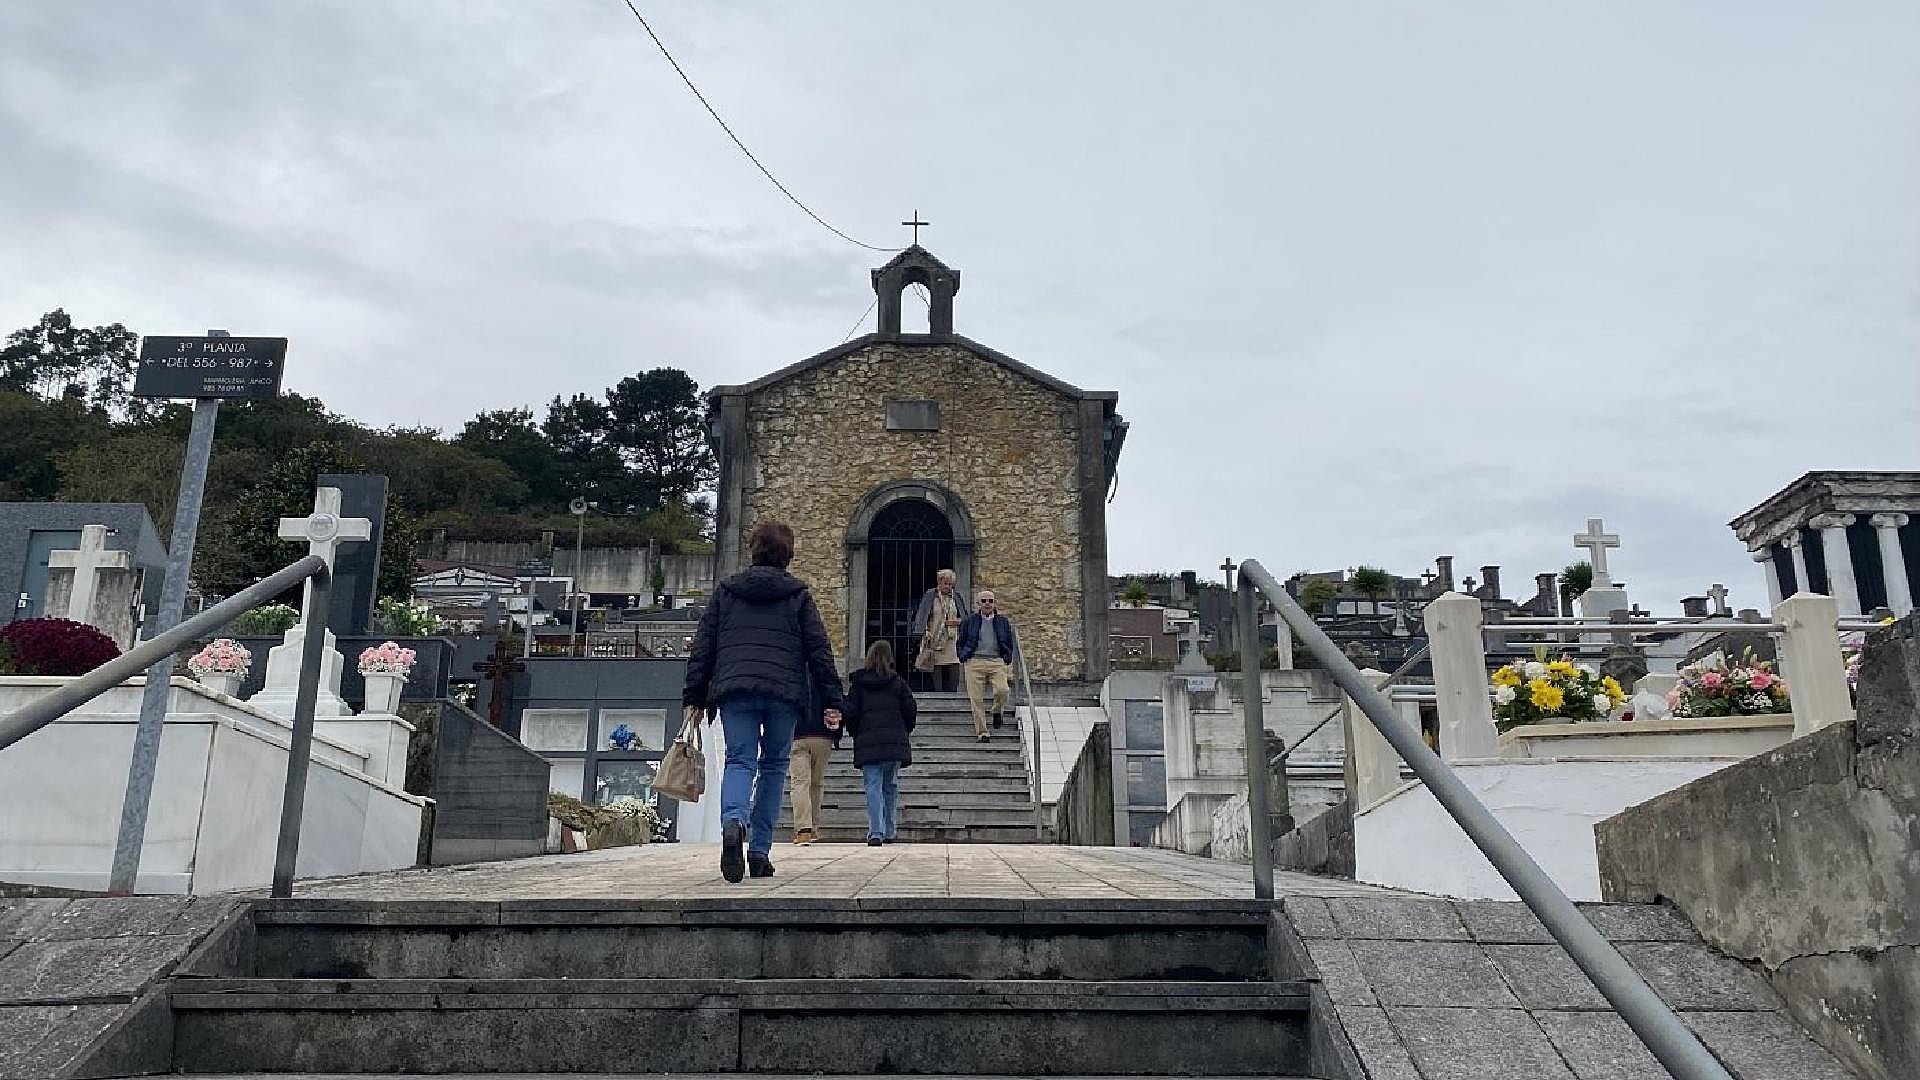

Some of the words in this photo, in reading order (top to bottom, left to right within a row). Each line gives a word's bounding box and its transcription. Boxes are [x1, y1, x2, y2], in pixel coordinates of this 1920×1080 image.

[202, 342, 246, 353] PLANTA
[166, 357, 189, 368] DEL
[192, 357, 217, 368] 556
[229, 357, 253, 368] 987
